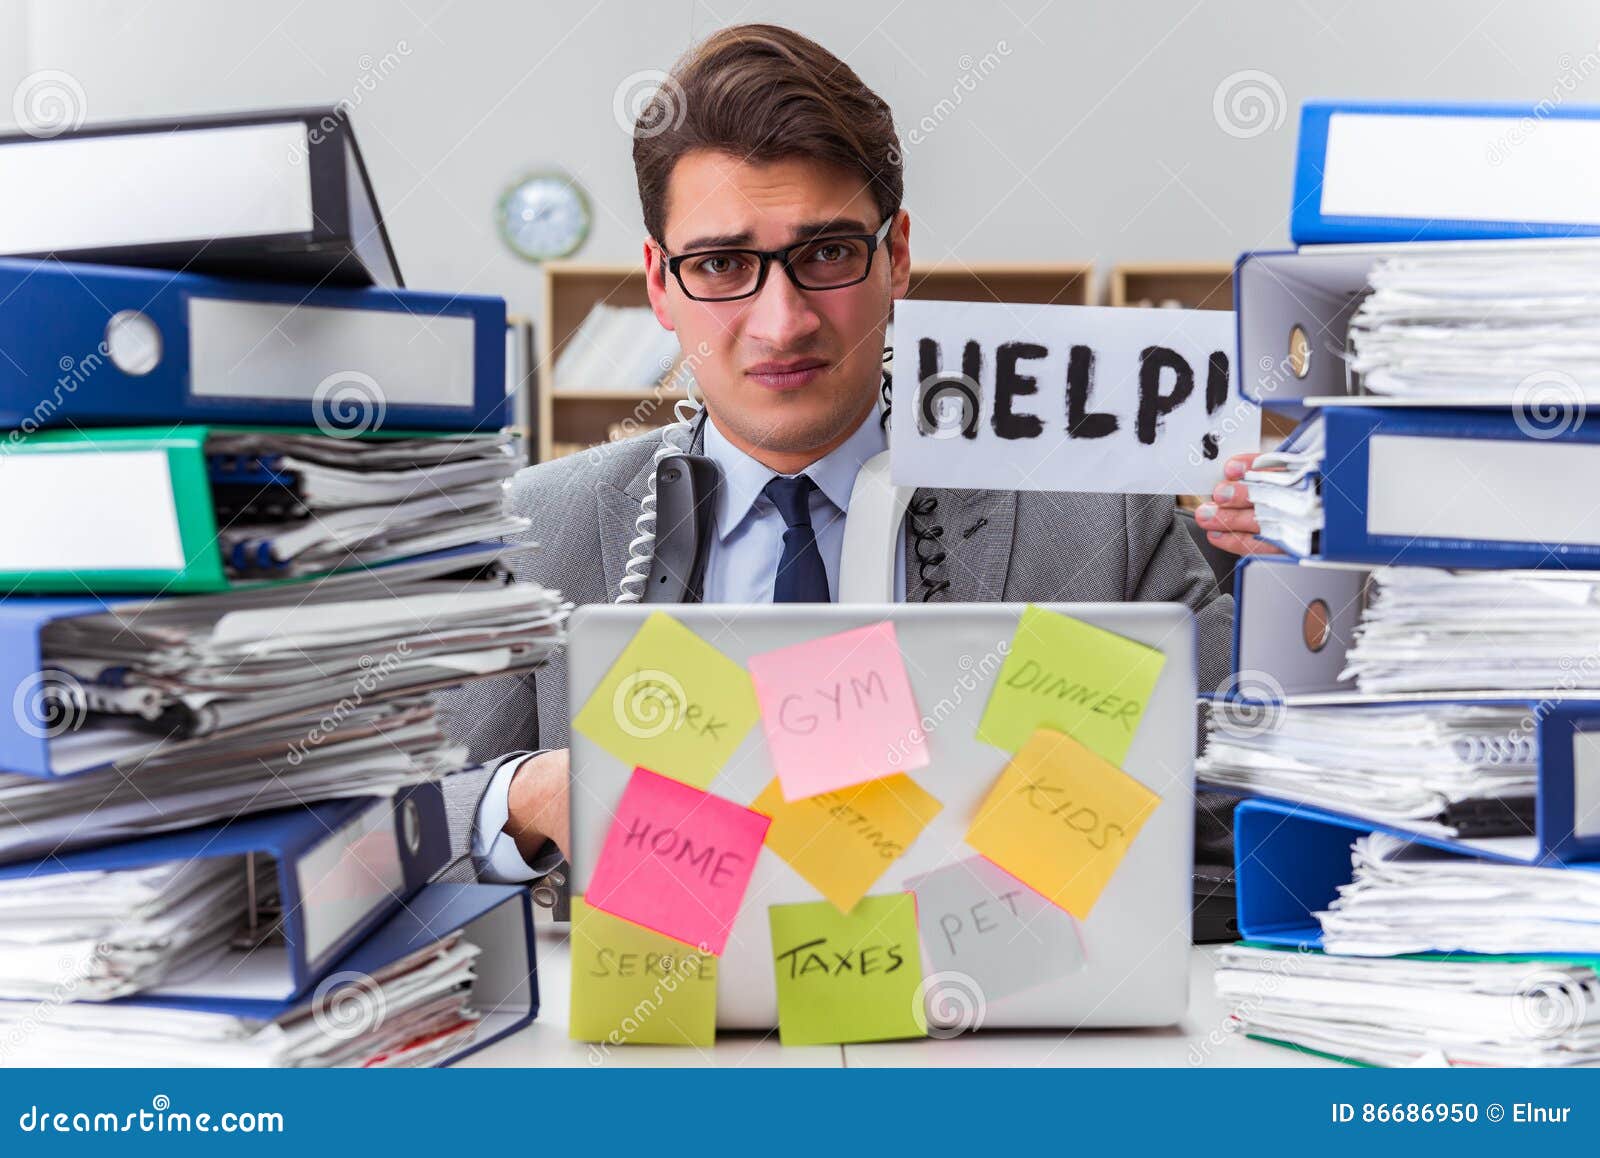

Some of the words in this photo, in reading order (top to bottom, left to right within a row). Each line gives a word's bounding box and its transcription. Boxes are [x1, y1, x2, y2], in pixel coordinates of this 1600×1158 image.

[918, 337, 1230, 460] HELP!
[779, 669, 889, 735] GYM
[1005, 659, 1140, 732] DINNER
[1015, 776, 1125, 852] KIDS
[623, 816, 745, 888] HOME
[776, 937, 904, 981] TAXES
[939, 890, 1022, 956] PET
